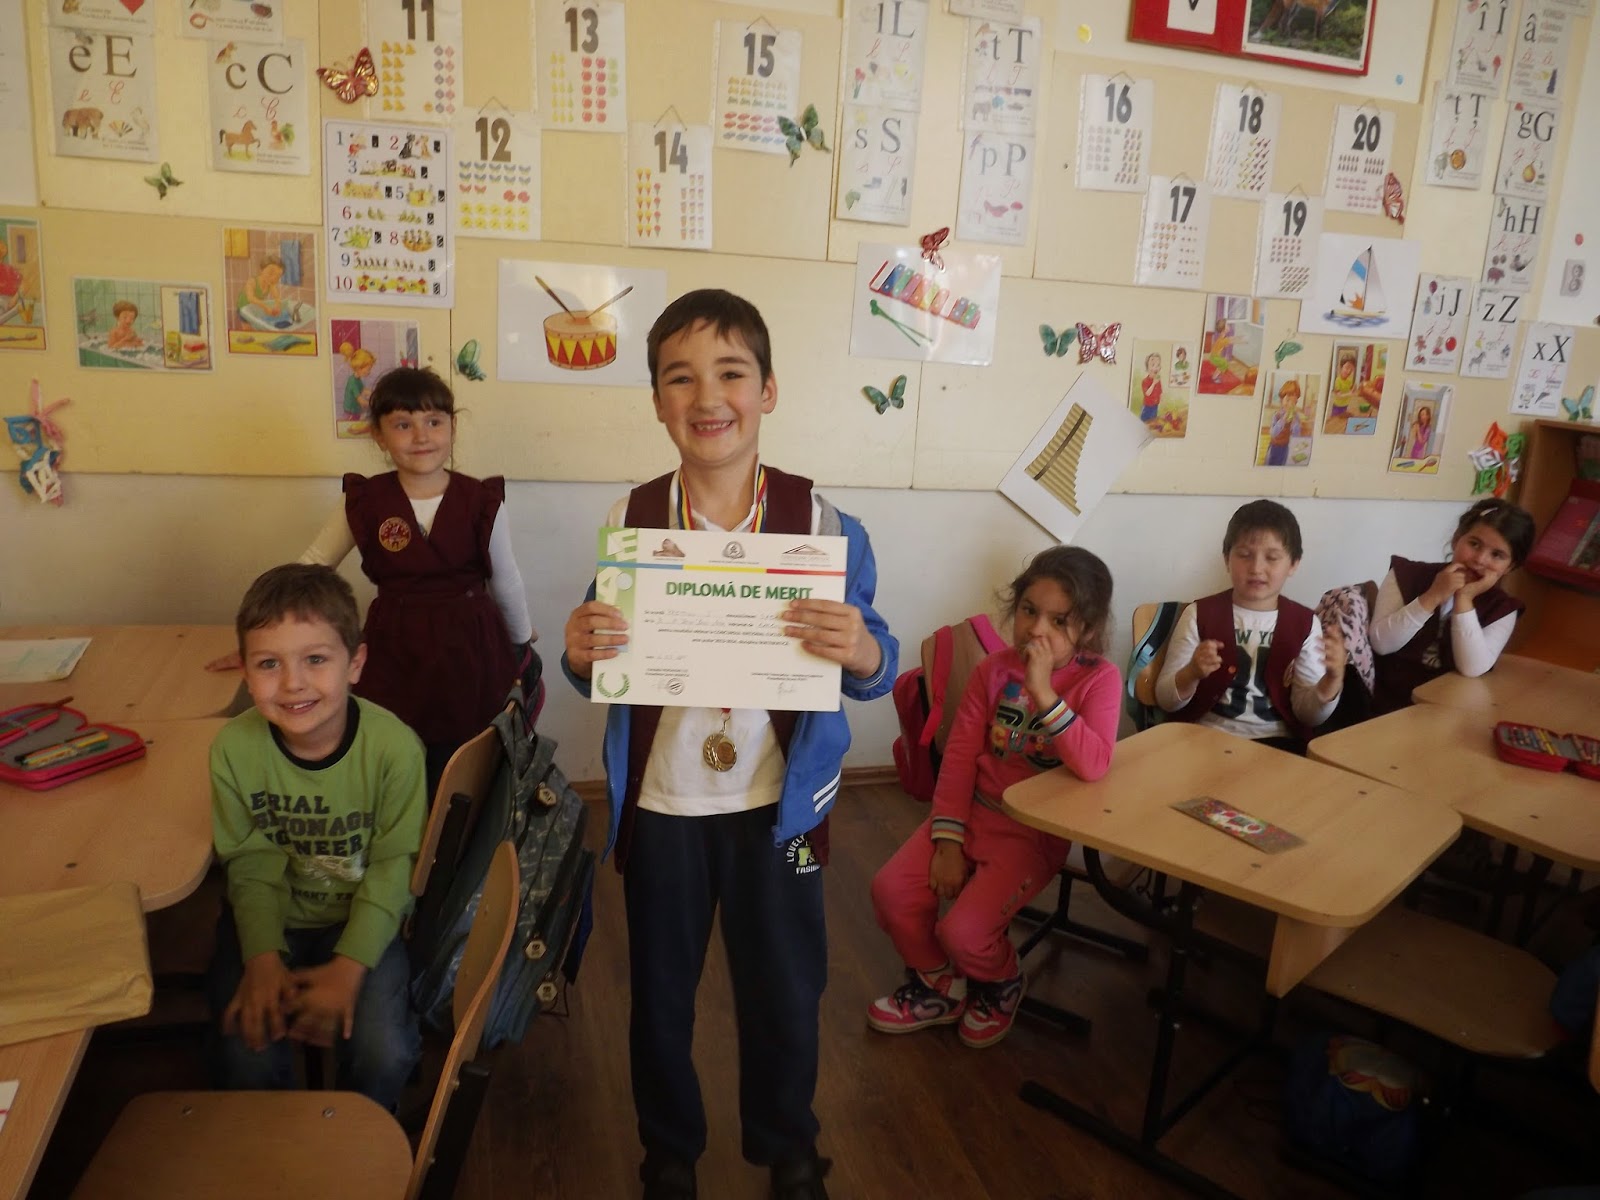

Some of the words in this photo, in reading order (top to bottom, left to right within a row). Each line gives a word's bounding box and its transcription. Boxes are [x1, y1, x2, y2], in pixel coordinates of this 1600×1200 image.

[401, 0, 436, 42] 11
[565, 7, 600, 54] 13
[744, 32, 776, 78] 15
[1105, 83, 1132, 124] 16
[1238, 95, 1264, 134] 18
[337, 131, 344, 145] 1
[390, 135, 399, 150] 2
[475, 117, 511, 162] 12
[1351, 114, 1381, 151] 20
[348, 159, 357, 174] 3
[654, 131, 688, 174] 14
[332, 181, 340, 195] 4
[396, 186, 404, 200] 5
[1170, 186, 1197, 223] 17
[342, 206, 352, 220] 6
[1283, 201, 1307, 236] 19
[331, 227, 340, 242] 7
[390, 231, 398, 245] 8
[341, 253, 350, 267] 9
[335, 276, 352, 290] 10
[741, 585, 761, 599] DE
[765, 586, 814, 601] MERIT
[786, 834, 805, 863] LOVELY
